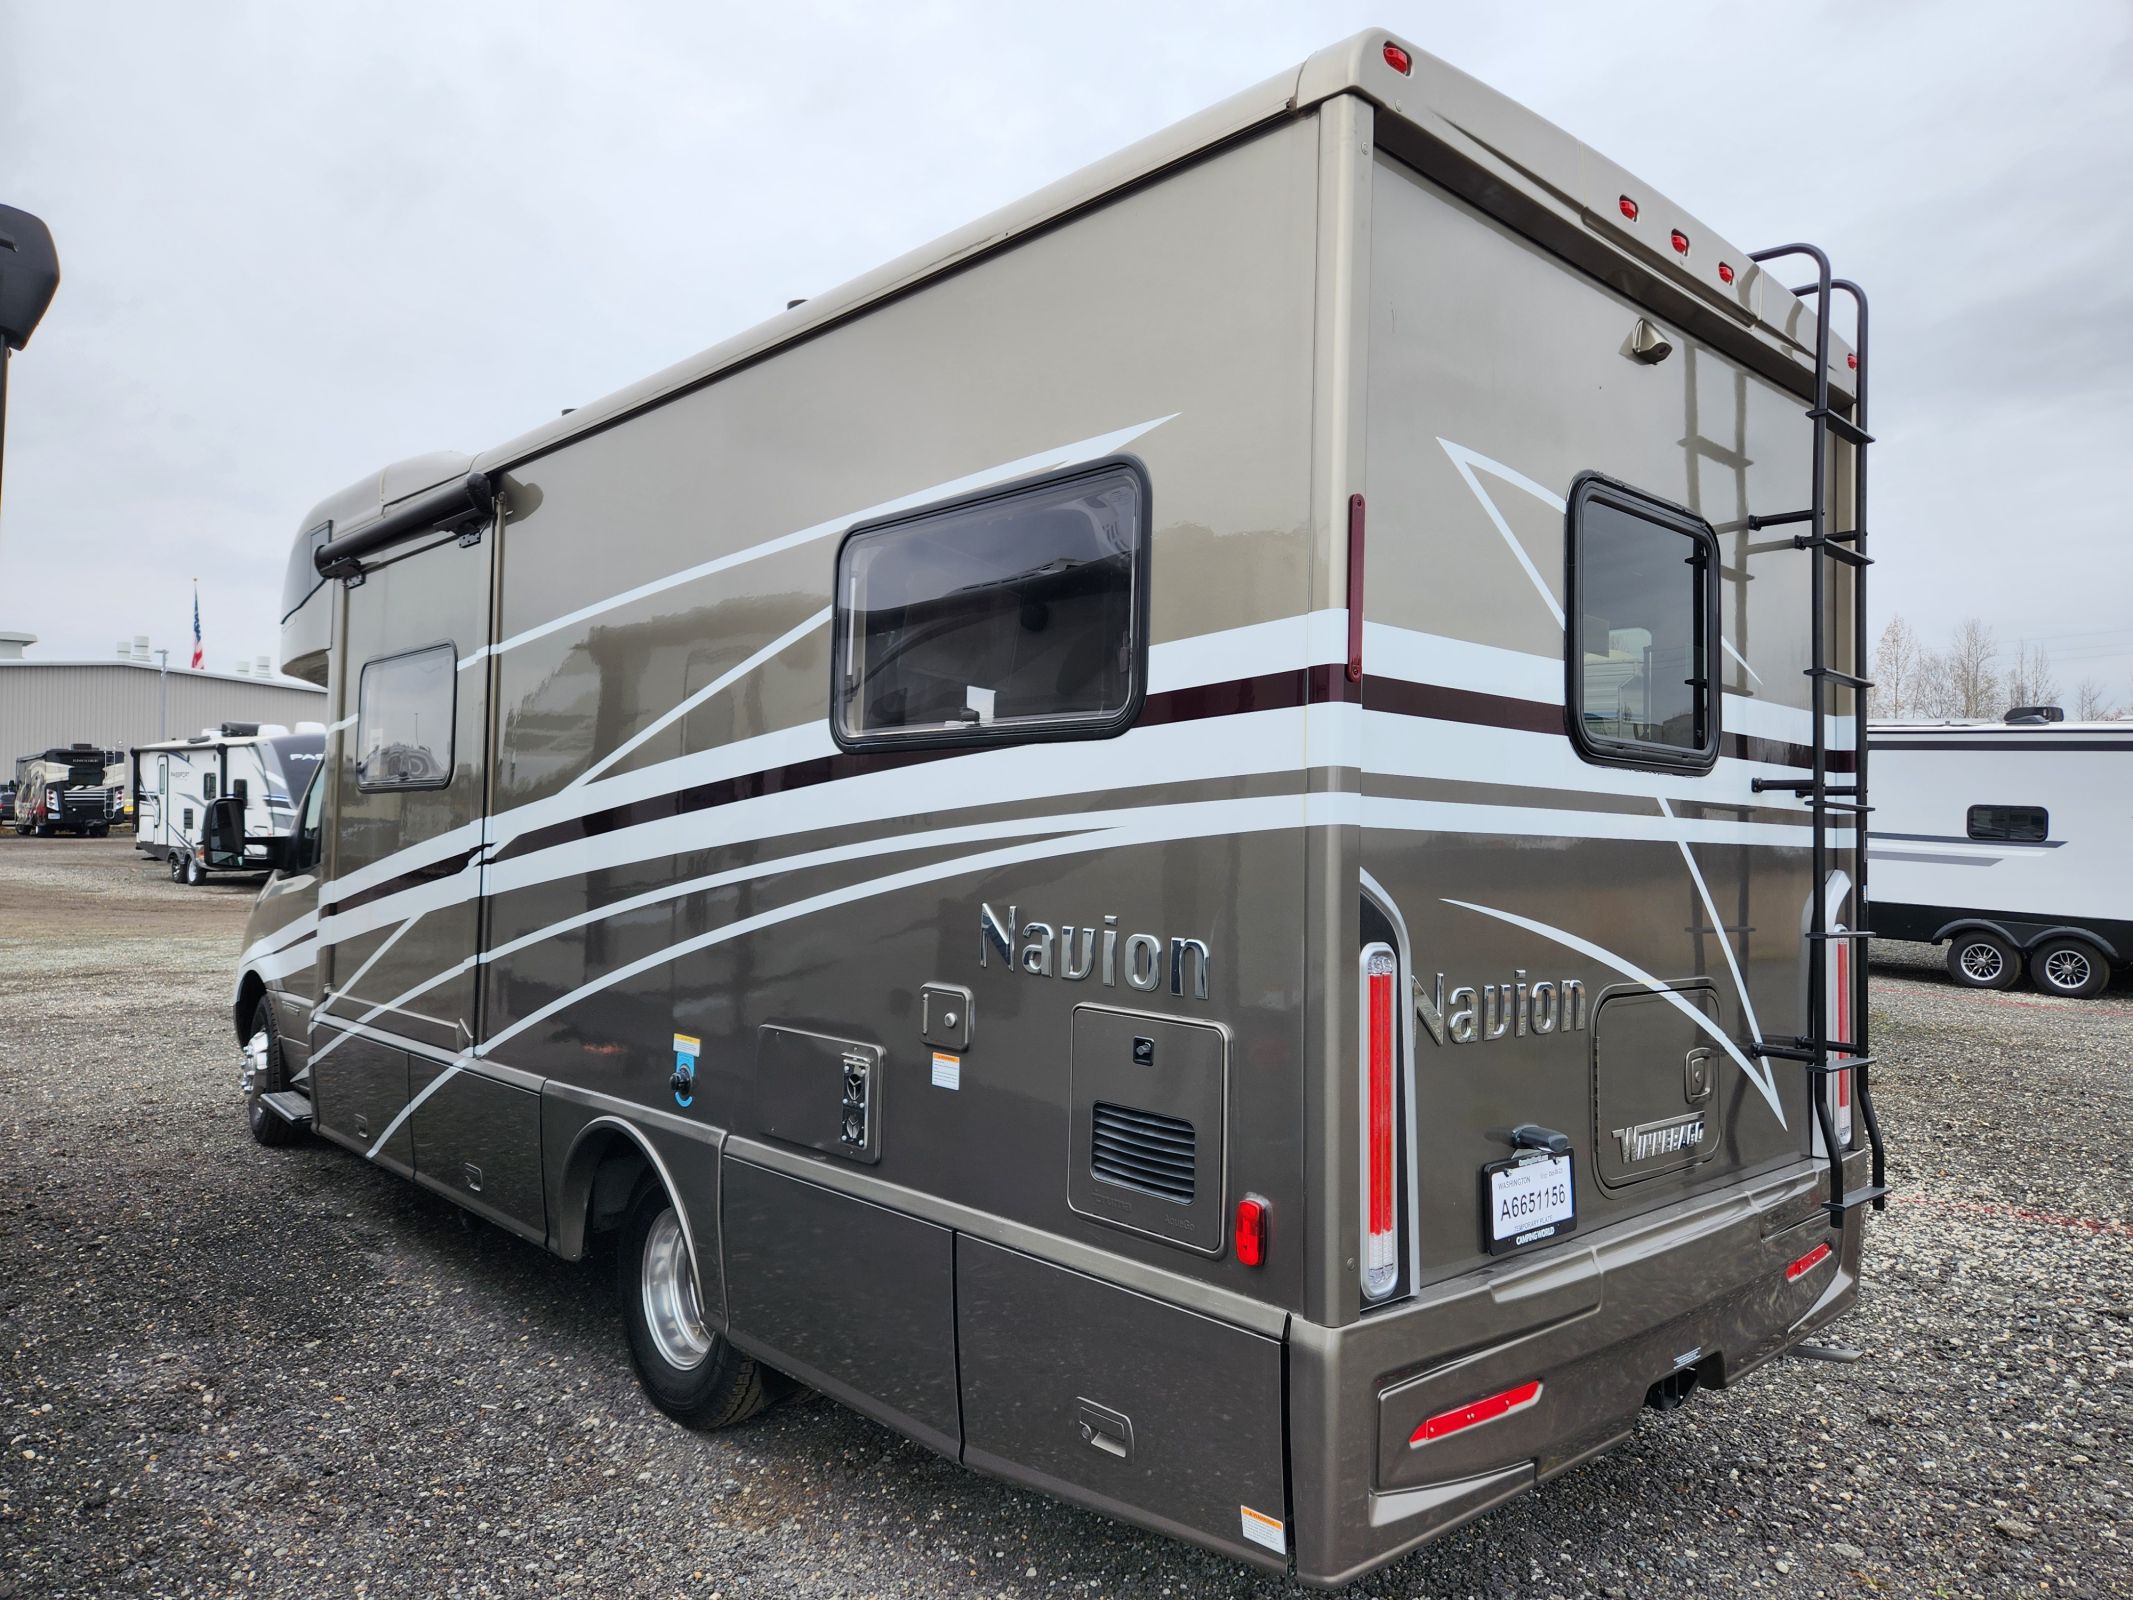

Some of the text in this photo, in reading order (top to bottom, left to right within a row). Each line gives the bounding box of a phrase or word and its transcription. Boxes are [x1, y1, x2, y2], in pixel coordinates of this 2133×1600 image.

[979, 902, 1210, 1001] Navion
[1411, 969, 1586, 1048] Navion
[1498, 1175, 1531, 1190] WASHINGTON
[1501, 1183, 1566, 1221] A6651156
[1513, 1215, 1553, 1232] TEMPORARY PLATE
